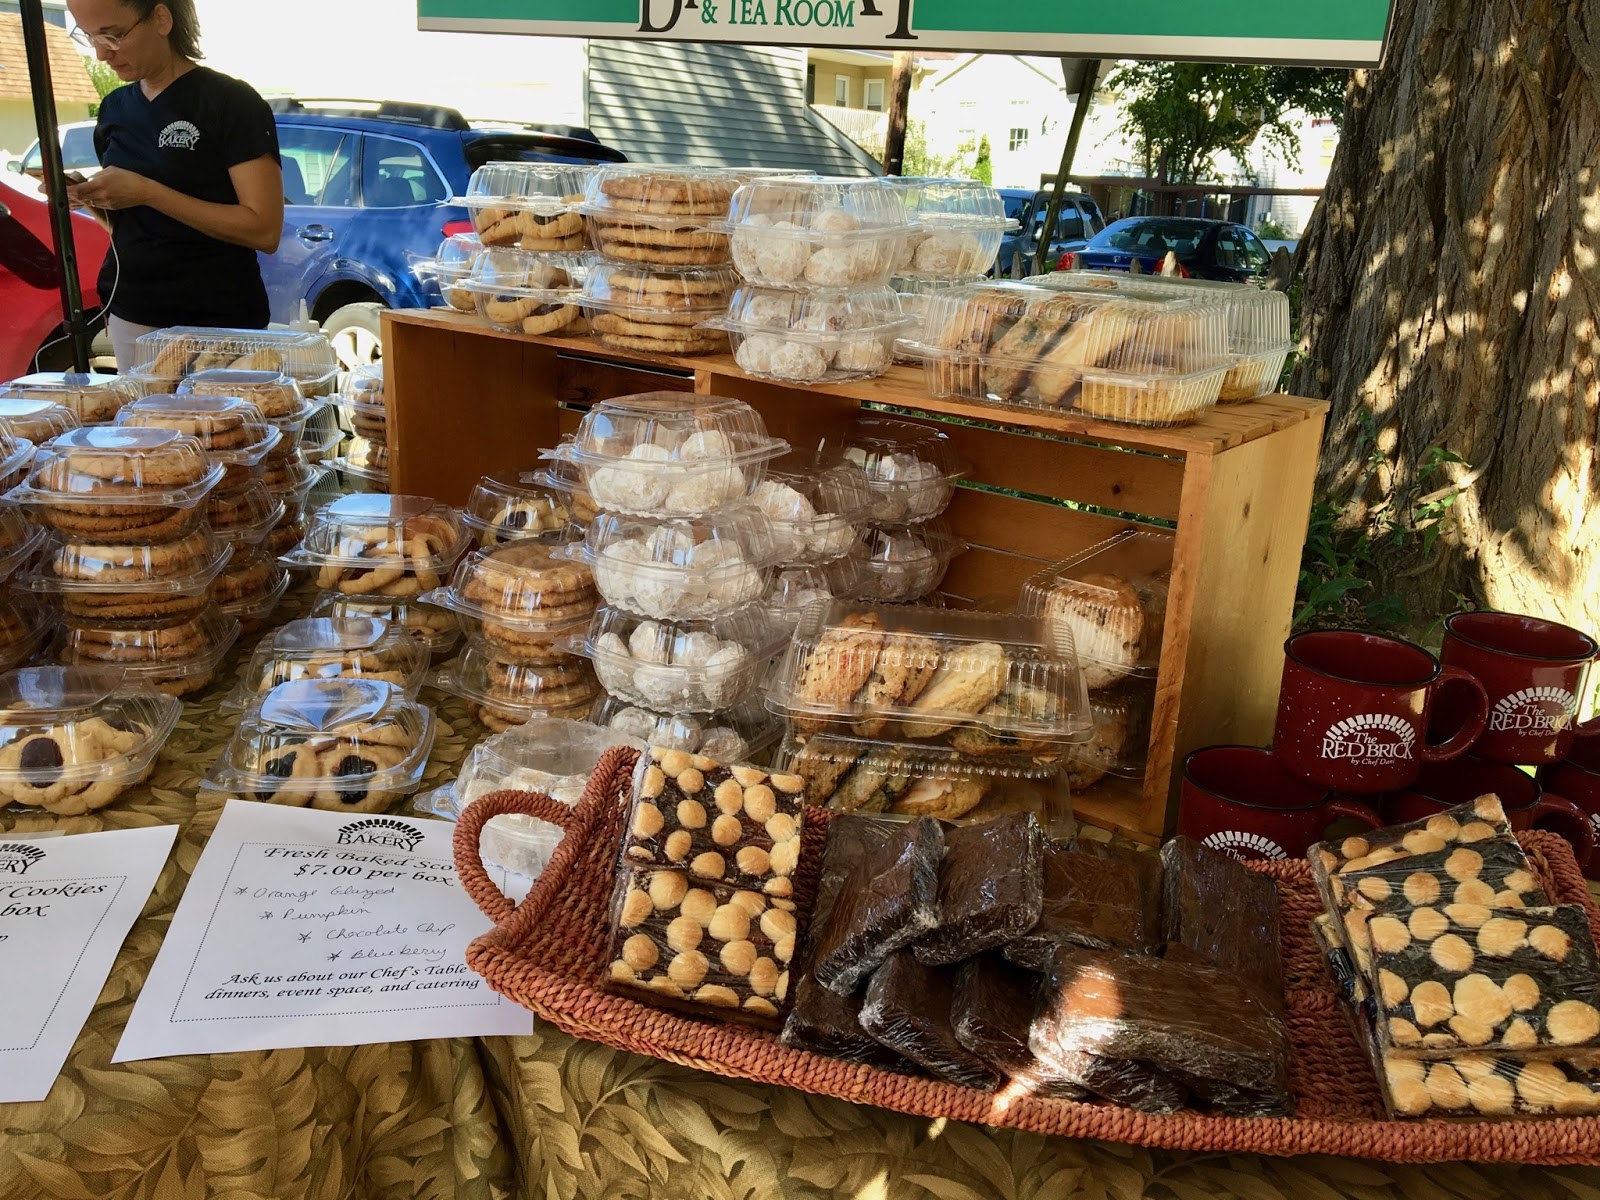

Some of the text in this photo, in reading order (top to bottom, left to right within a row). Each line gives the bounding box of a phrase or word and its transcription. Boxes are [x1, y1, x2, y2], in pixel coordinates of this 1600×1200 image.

[701, 0, 718, 24] &
[728, 0, 768, 25] TEA
[774, 0, 855, 27] ROOM
[158, 133, 200, 151] BAKERY
[1522, 704, 1546, 716] The
[1489, 711, 1532, 731] RED
[1353, 732, 1378, 744] The
[1528, 729, 1544, 737] Chef
[1321, 738, 1416, 759] RED BRICK
[1351, 758, 1360, 766] by
[1361, 758, 1378, 767] Chef
[336, 832, 424, 853] BAKERY
[264, 848, 457, 872] Fresh Baked Sco
[1223, 847, 1247, 861] The
[293, 863, 454, 887] $7.00 per box
[9, 883, 108, 899] Cookies
[253, 886, 395, 902] Orange Glazed
[0, 902, 51, 917] box
[282, 902, 373, 922] Pumpkin
[326, 922, 456, 940] Chocolate Chip
[222, 964, 467, 985] Ask us about our Chef's Table
[204, 978, 480, 1000] dinners, event space, and catering
